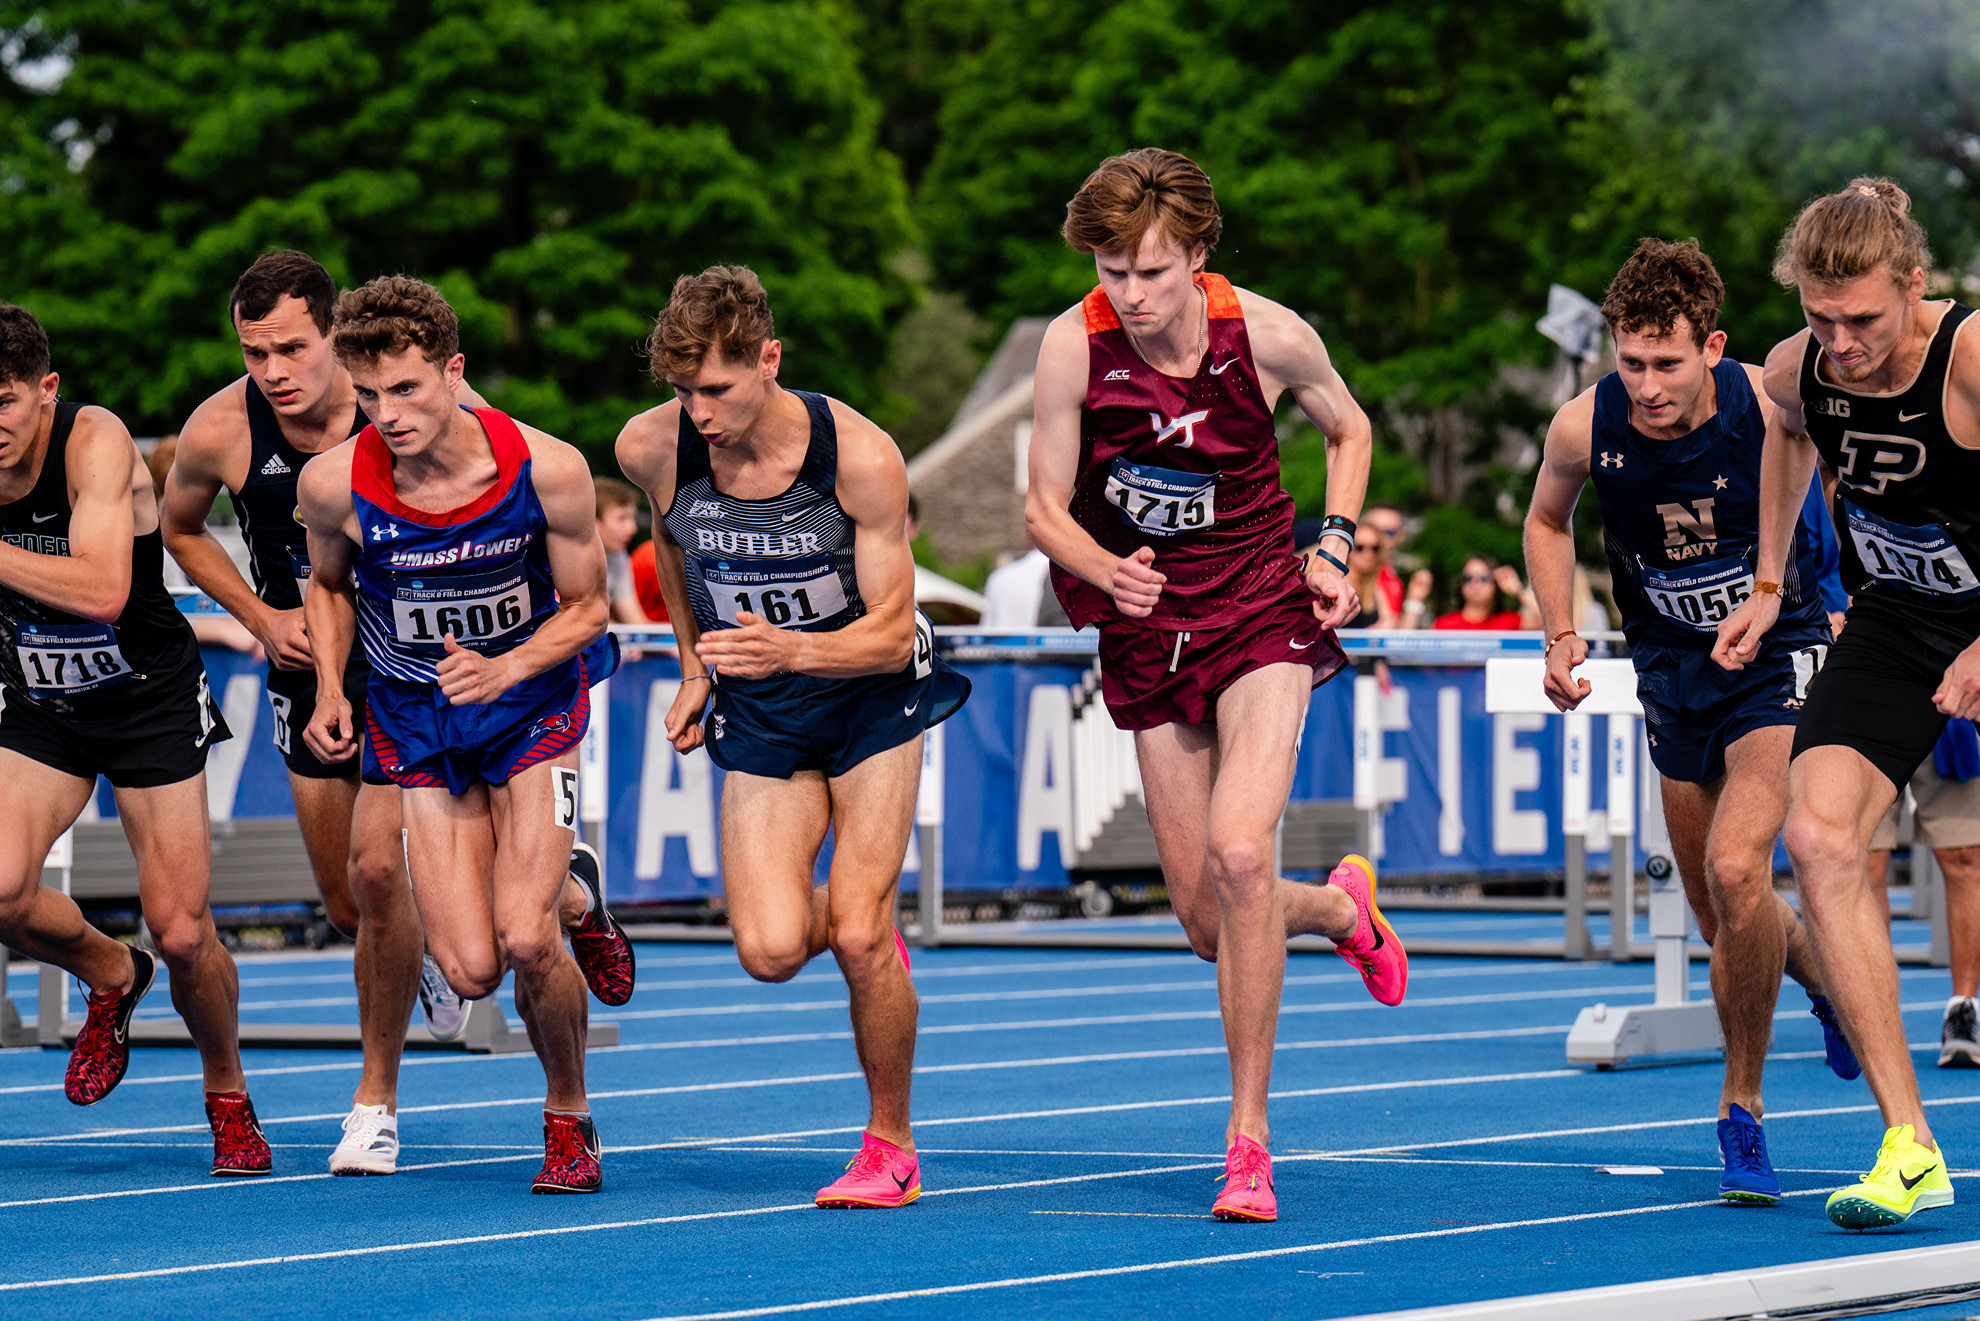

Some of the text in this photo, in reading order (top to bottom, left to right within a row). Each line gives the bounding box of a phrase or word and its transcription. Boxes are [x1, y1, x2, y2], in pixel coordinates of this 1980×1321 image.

[1104, 369, 1130, 378] ACC
[1149, 408, 1212, 448] VT
[261, 466, 291, 475] adidas
[1838, 430, 1926, 495] P
[688, 509, 728, 519] EAST
[693, 500, 721, 510] BIG
[1115, 487, 1206, 527] 1715
[1656, 497, 1717, 547] N
[696, 528, 822, 555] BUTLER
[1666, 542, 1718, 561] NAVY
[720, 574, 743, 582] TRACK
[749, 574, 769, 582] FIELD
[770, 564, 829, 580] CHAMPIONSHIPS
[1682, 578, 1697, 587] FIELD
[1697, 566, 1743, 583] CHAMPIONSHIPS
[1865, 539, 1962, 590] 1374
[464, 575, 522, 597] CHAMPIONSHIPS
[1657, 581, 1752, 624] 1055
[408, 595, 521, 640] 1606
[734, 588, 820, 625] 161
[64, 634, 108, 644] CHAMPIONSHIPS
[28, 650, 121, 685] 1718
[273, 697, 286, 747] 6
[1376, 685, 1653, 855] FIE
[561, 771, 576, 826] 5
